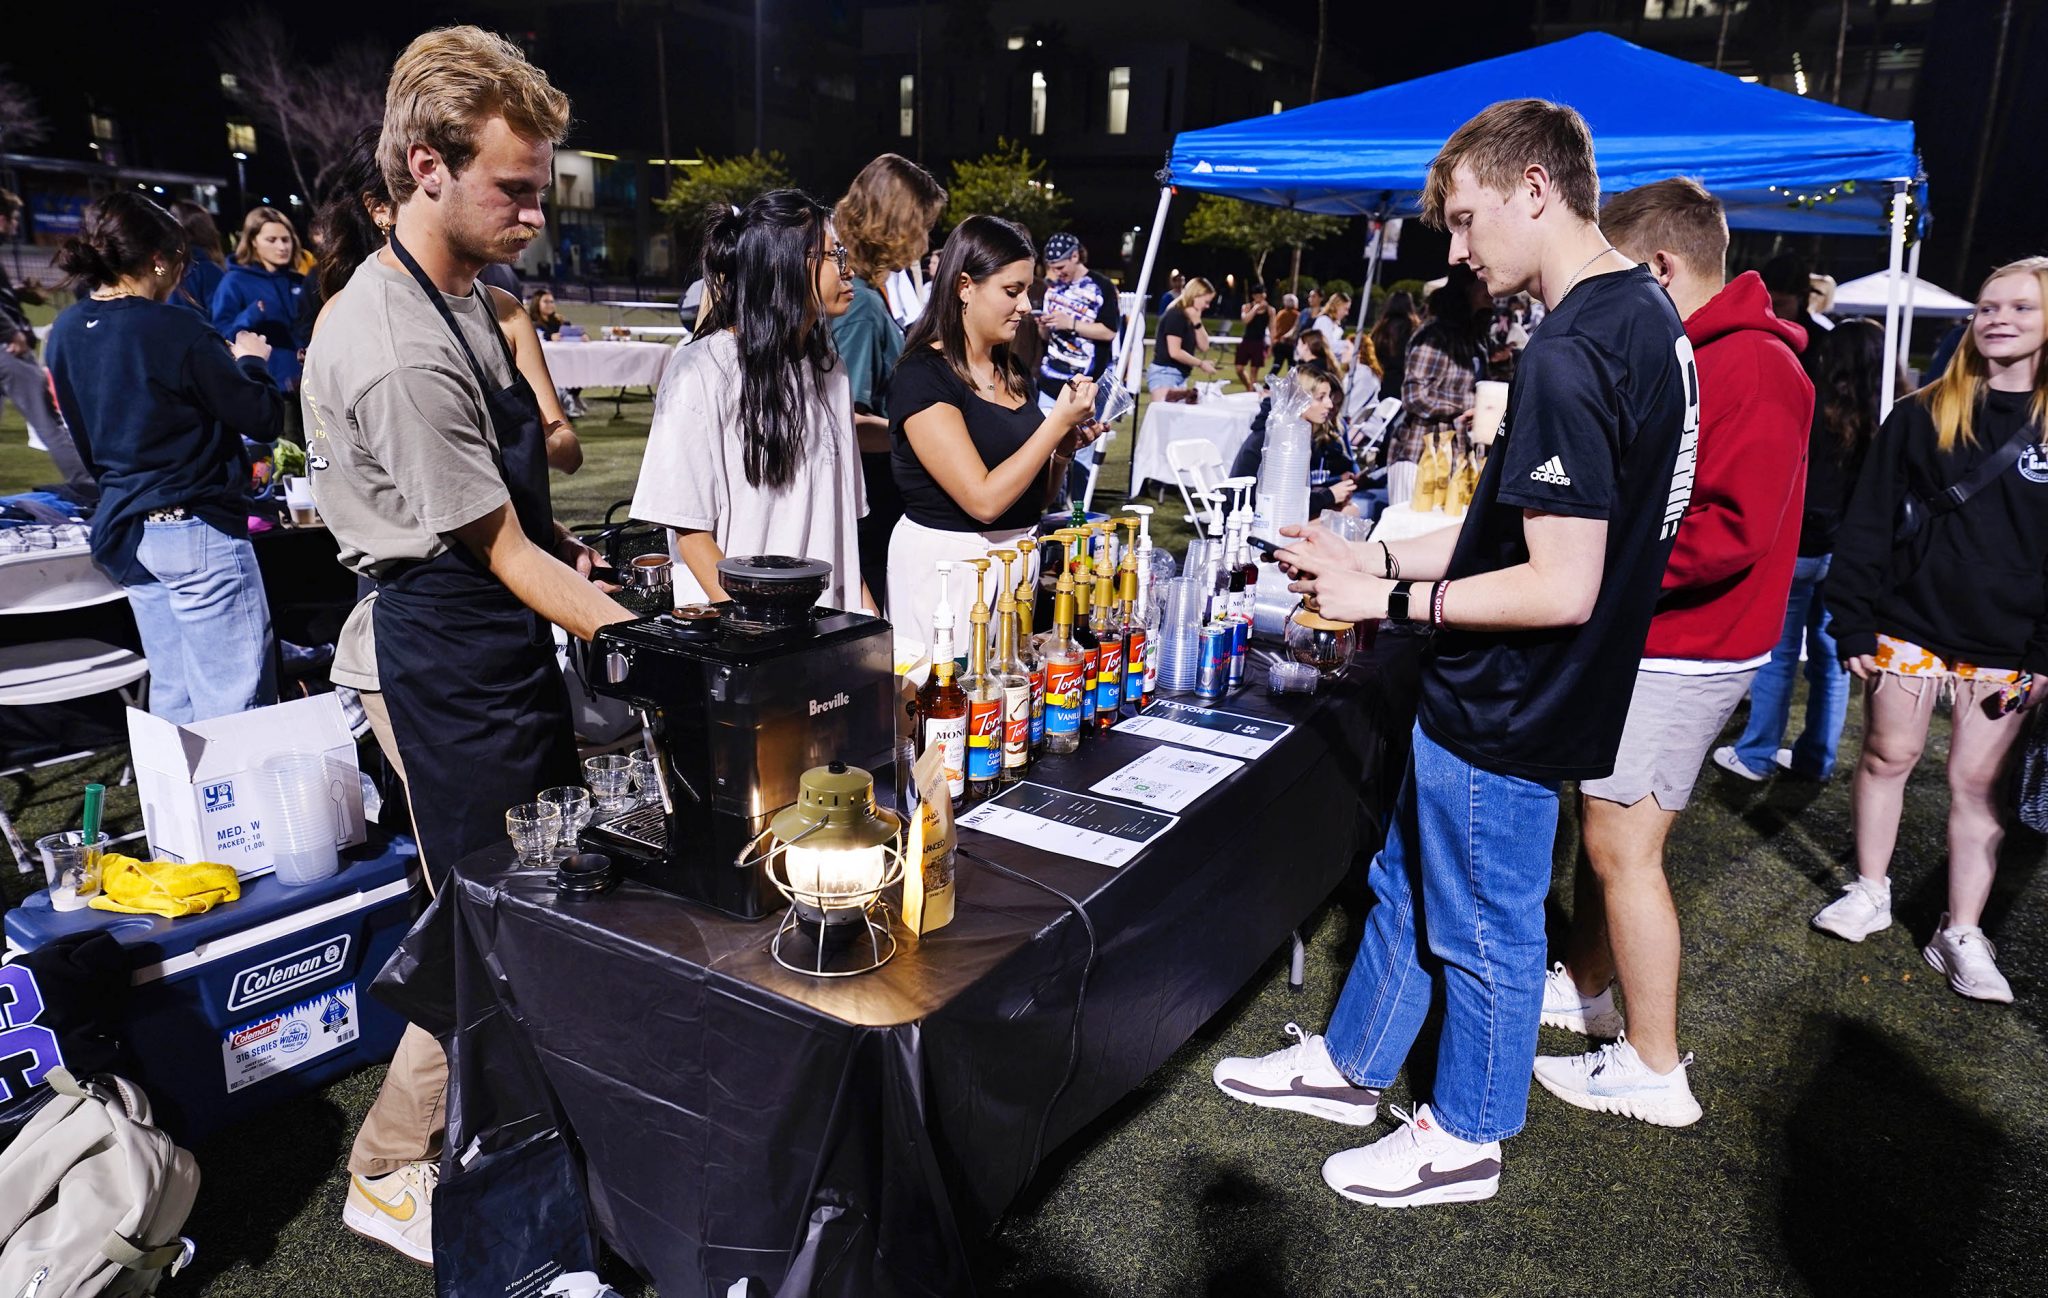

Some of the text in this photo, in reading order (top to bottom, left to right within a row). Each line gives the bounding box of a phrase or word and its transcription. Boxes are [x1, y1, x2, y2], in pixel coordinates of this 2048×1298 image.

[1530, 471, 1571, 486] adidas
[809, 692, 850, 716] Breville
[1158, 701, 1214, 716] FLAVORS
[217, 826, 246, 840] MED.
[218, 838, 245, 851] PACKED
[923, 840, 945, 853] LANCED
[243, 956, 321, 995] Coleman
[234, 1025, 271, 1046] Coleman
[280, 1032, 308, 1045] WICHITA
[235, 1040, 278, 1063] 316 SERIES
[511, 1278, 523, 1288] Four
